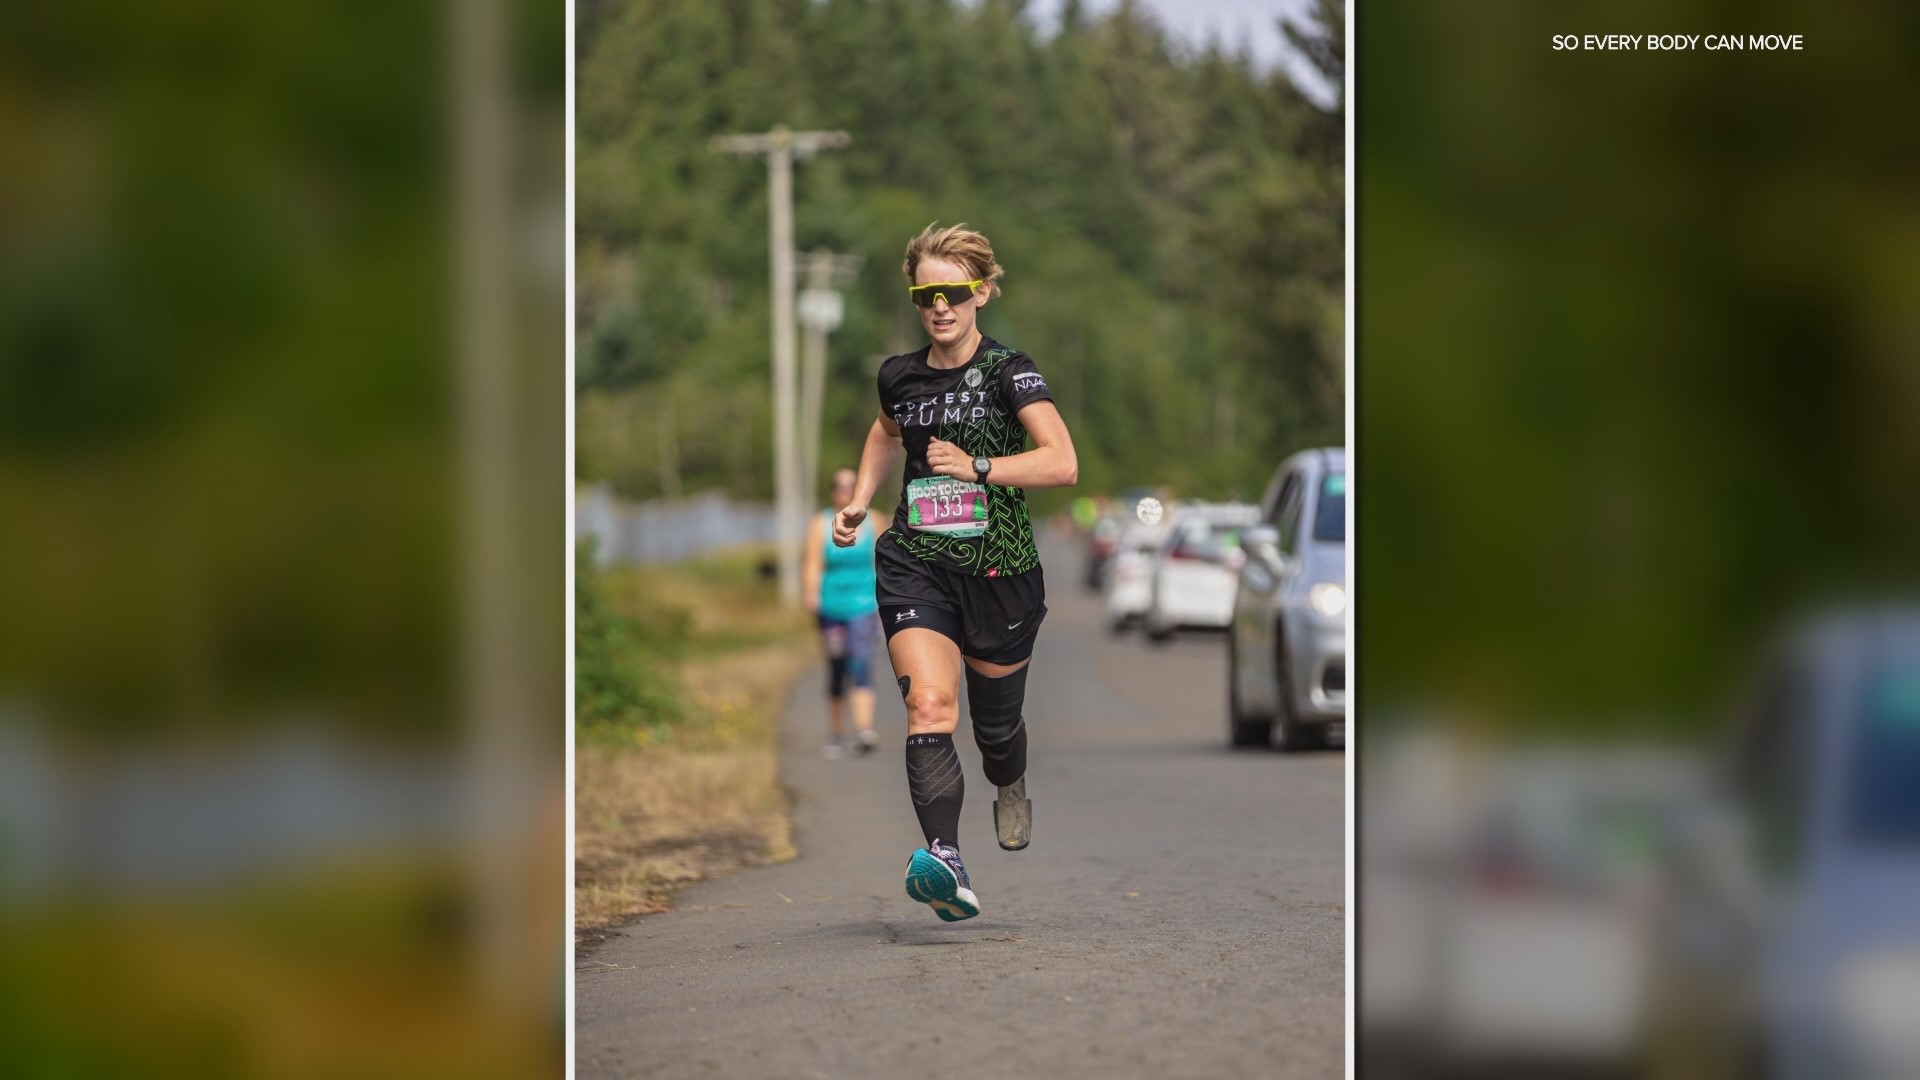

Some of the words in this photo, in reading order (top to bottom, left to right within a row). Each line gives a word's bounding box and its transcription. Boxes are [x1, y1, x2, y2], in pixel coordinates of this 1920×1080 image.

[910, 485, 938, 499] HOOD
[938, 484, 951, 496] TO
[931, 494, 963, 519] 133
